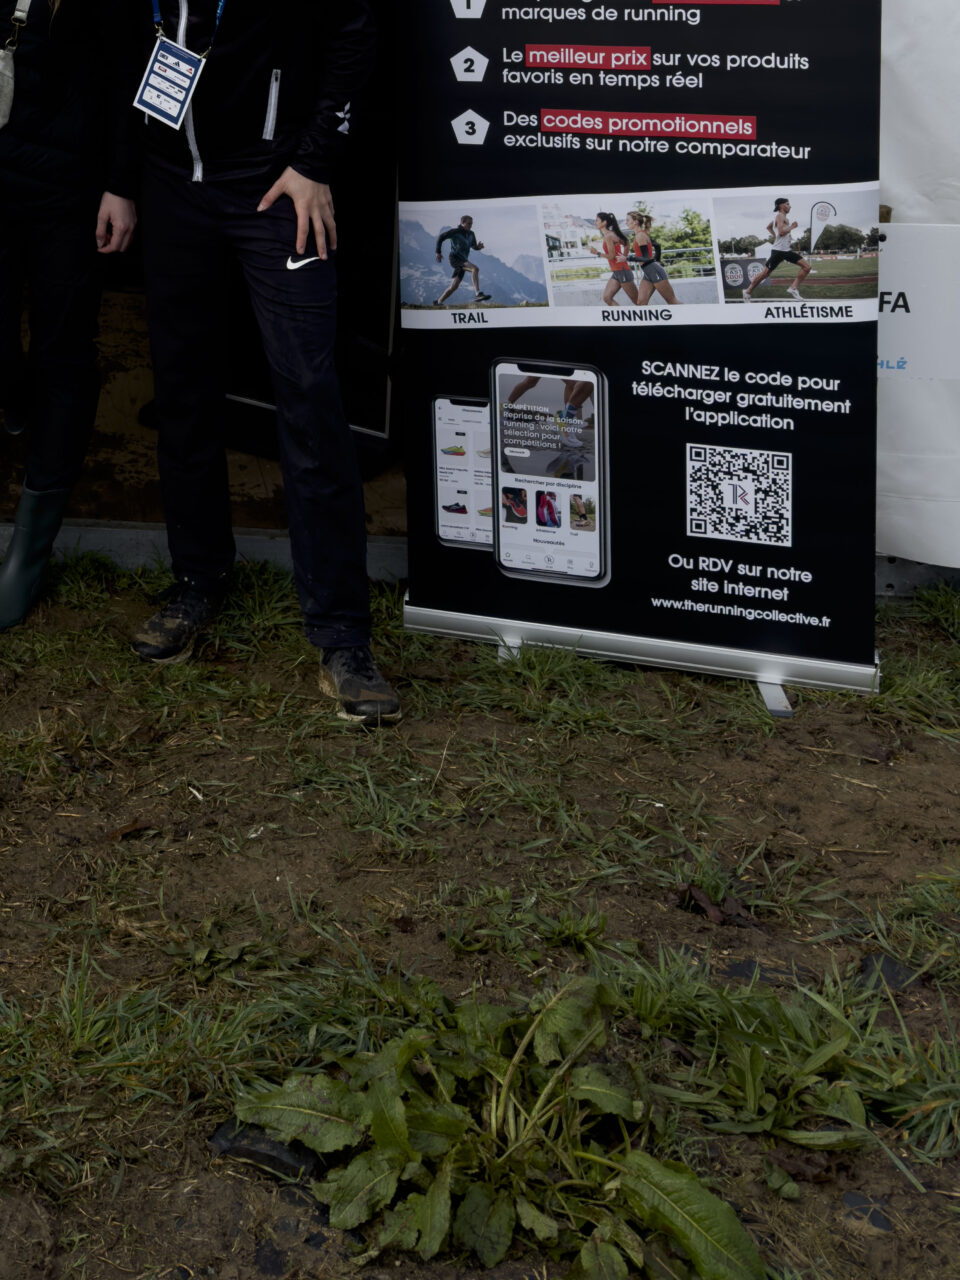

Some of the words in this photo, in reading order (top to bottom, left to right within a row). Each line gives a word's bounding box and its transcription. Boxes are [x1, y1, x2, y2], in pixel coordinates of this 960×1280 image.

[502, 6, 586, 24] marques
[592, 4, 618, 21] de
[624, 6, 701, 26] running
[464, 59, 475, 73] 2
[503, 48, 523, 63] Le
[529, 49, 605, 65] meilleur
[611, 50, 647, 69] prix
[653, 54, 681, 67] sur
[687, 54, 720, 68] vos
[726, 52, 809, 72] produits
[503, 69, 564, 85] favoris
[569, 73, 593, 86] en
[599, 72, 660, 89] temps
[666, 72, 703, 88] réel
[465, 121, 476, 136] 3
[504, 111, 538, 127] Des
[543, 113, 603, 130] codes
[609, 115, 753, 136] promotionnels
[504, 132, 580, 150] exclusifs
[586, 138, 613, 151] sur
[619, 138, 669, 154] notre
[676, 139, 811, 160] comparateur
[452, 312, 488, 325] TRAIL
[602, 309, 673, 322] RUNNING
[765, 303, 853, 319] ATHLÉTISME
[642, 361, 720, 381] SCANNEZ
[725, 366, 740, 382] le
[745, 367, 793, 387] code
[798, 376, 840, 393] pour
[632, 381, 731, 404] télécharger
[737, 389, 851, 414] gratuitement
[504, 412, 533, 420] Reprise
[685, 406, 794, 431] l'application
[504, 421, 534, 430] running
[561, 425, 583, 433] notre
[504, 429, 540, 438] sélection
[504, 438, 557, 448] compétitions
[668, 553, 693, 571] Ou
[699, 557, 732, 574] RDV
[738, 565, 762, 577] sur
[767, 564, 812, 582] notre
[691, 577, 719, 592] site
[724, 580, 789, 601] internet
[651, 597, 831, 628] www.therunningcollective.fr
